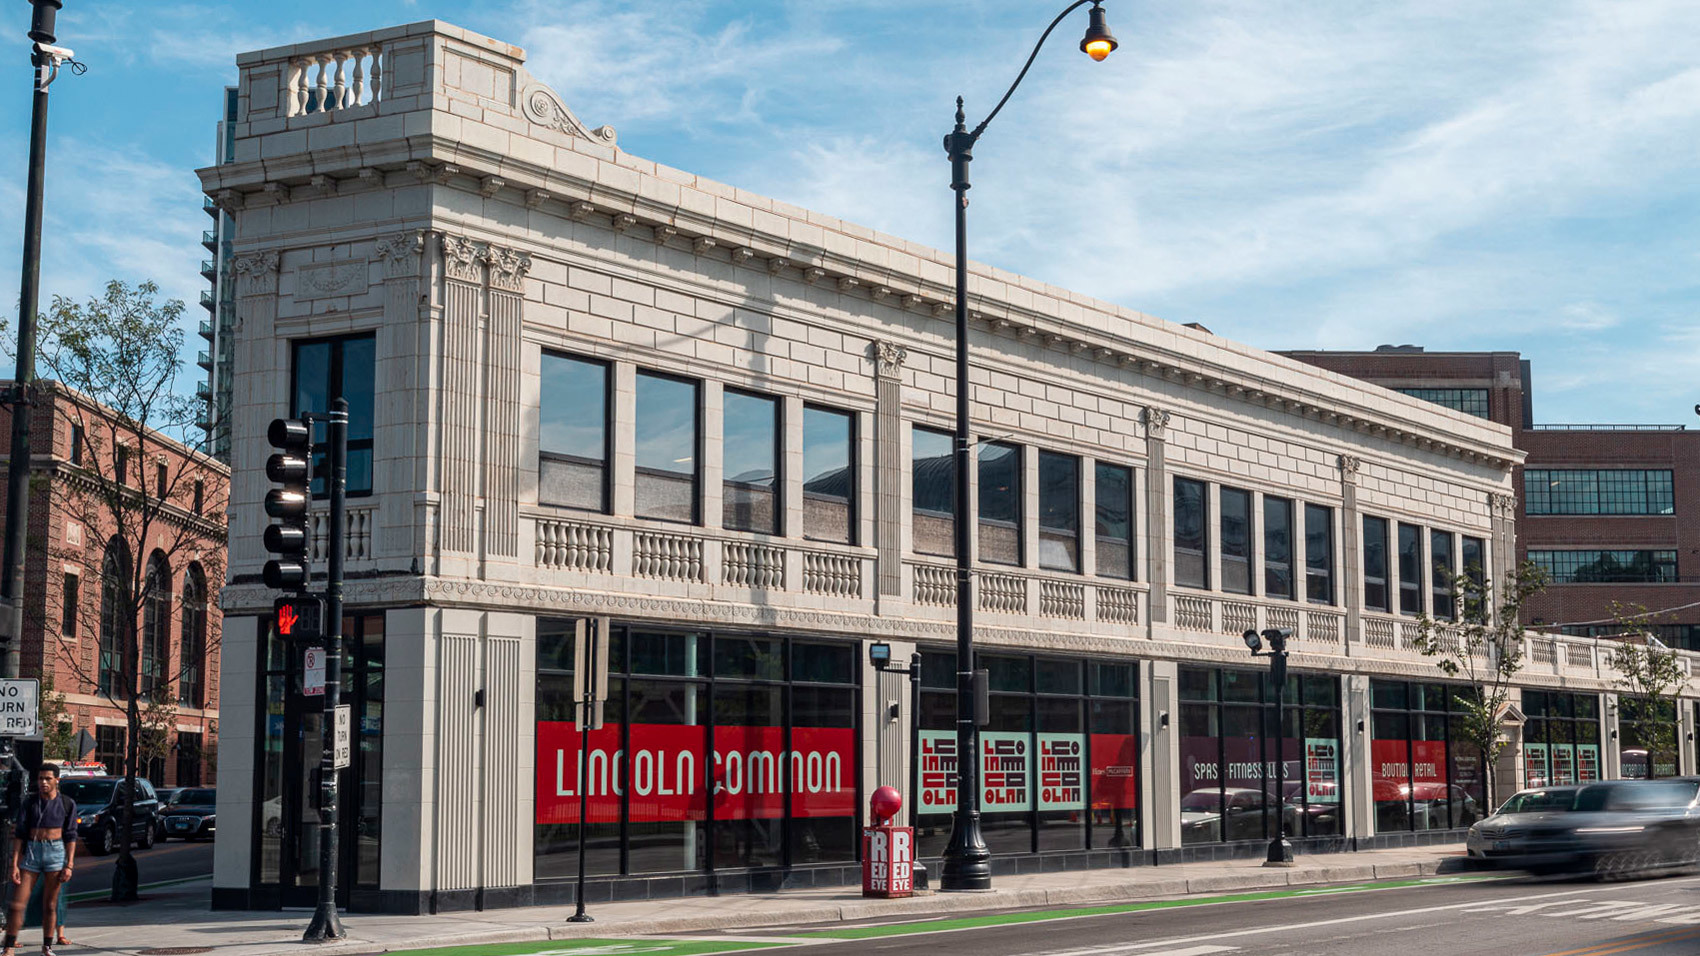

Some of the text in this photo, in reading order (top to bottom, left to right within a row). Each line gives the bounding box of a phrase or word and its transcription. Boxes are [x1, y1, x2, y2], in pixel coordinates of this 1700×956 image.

[0, 702, 24, 712] URN
[339, 714, 345, 725] NO
[338, 730, 347, 742] TURN
[556, 749, 841, 796] LINCOLN COMMON
[1194, 763, 1218, 780] SPAS
[871, 879, 887, 890] EYE
[893, 879, 910, 891] EYE
